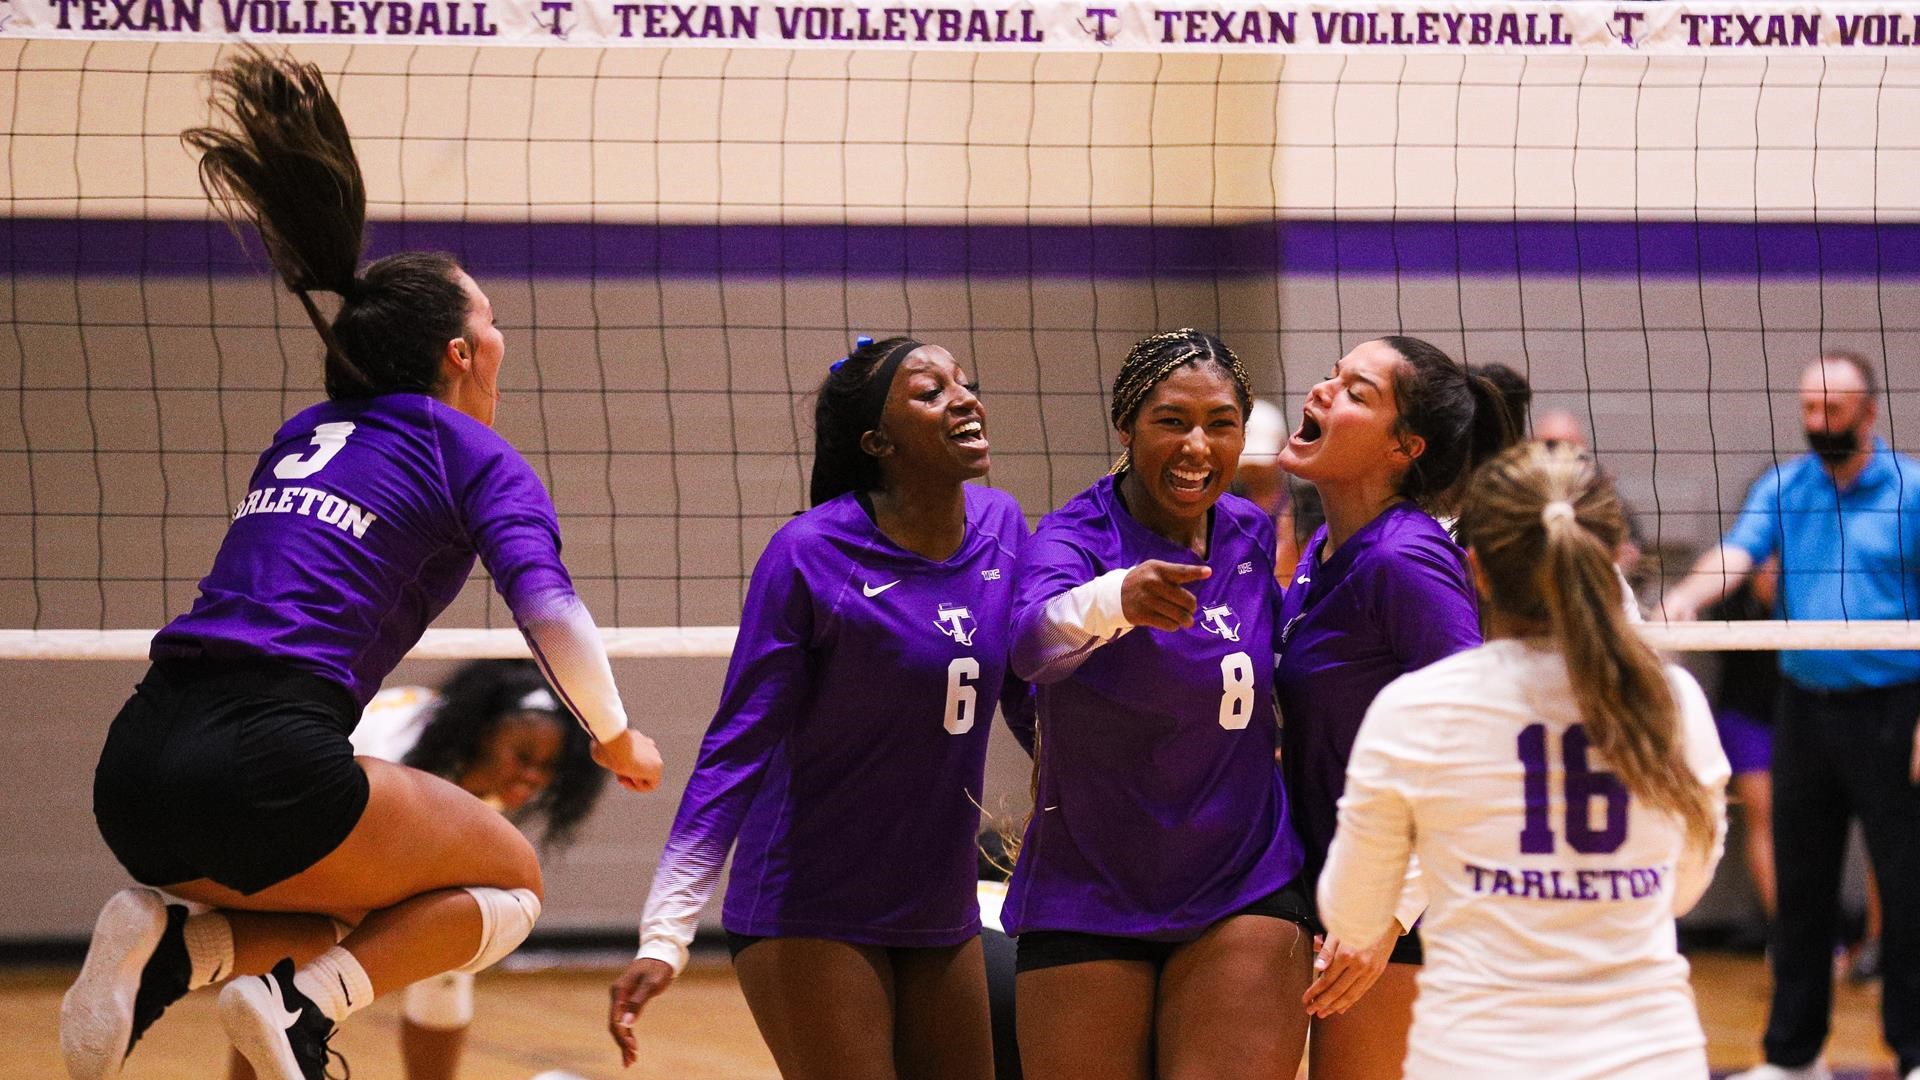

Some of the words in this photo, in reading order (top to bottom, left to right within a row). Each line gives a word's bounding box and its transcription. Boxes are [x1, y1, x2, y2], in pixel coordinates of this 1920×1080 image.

[49, 0, 204, 32] TEXAN
[218, 0, 498, 36] VOLLEYBALL
[613, 4, 760, 38] TEXAN
[775, 6, 1044, 42] VOLLEYBALL
[1154, 10, 1298, 43] TEXAN
[1311, 12, 1574, 45] VOLLEYBALL
[1680, 14, 1823, 46] TEXAN
[273, 421, 357, 479] 3
[943, 657, 980, 735] 6
[1218, 651, 1255, 731] 8
[1516, 723, 1629, 854] 16
